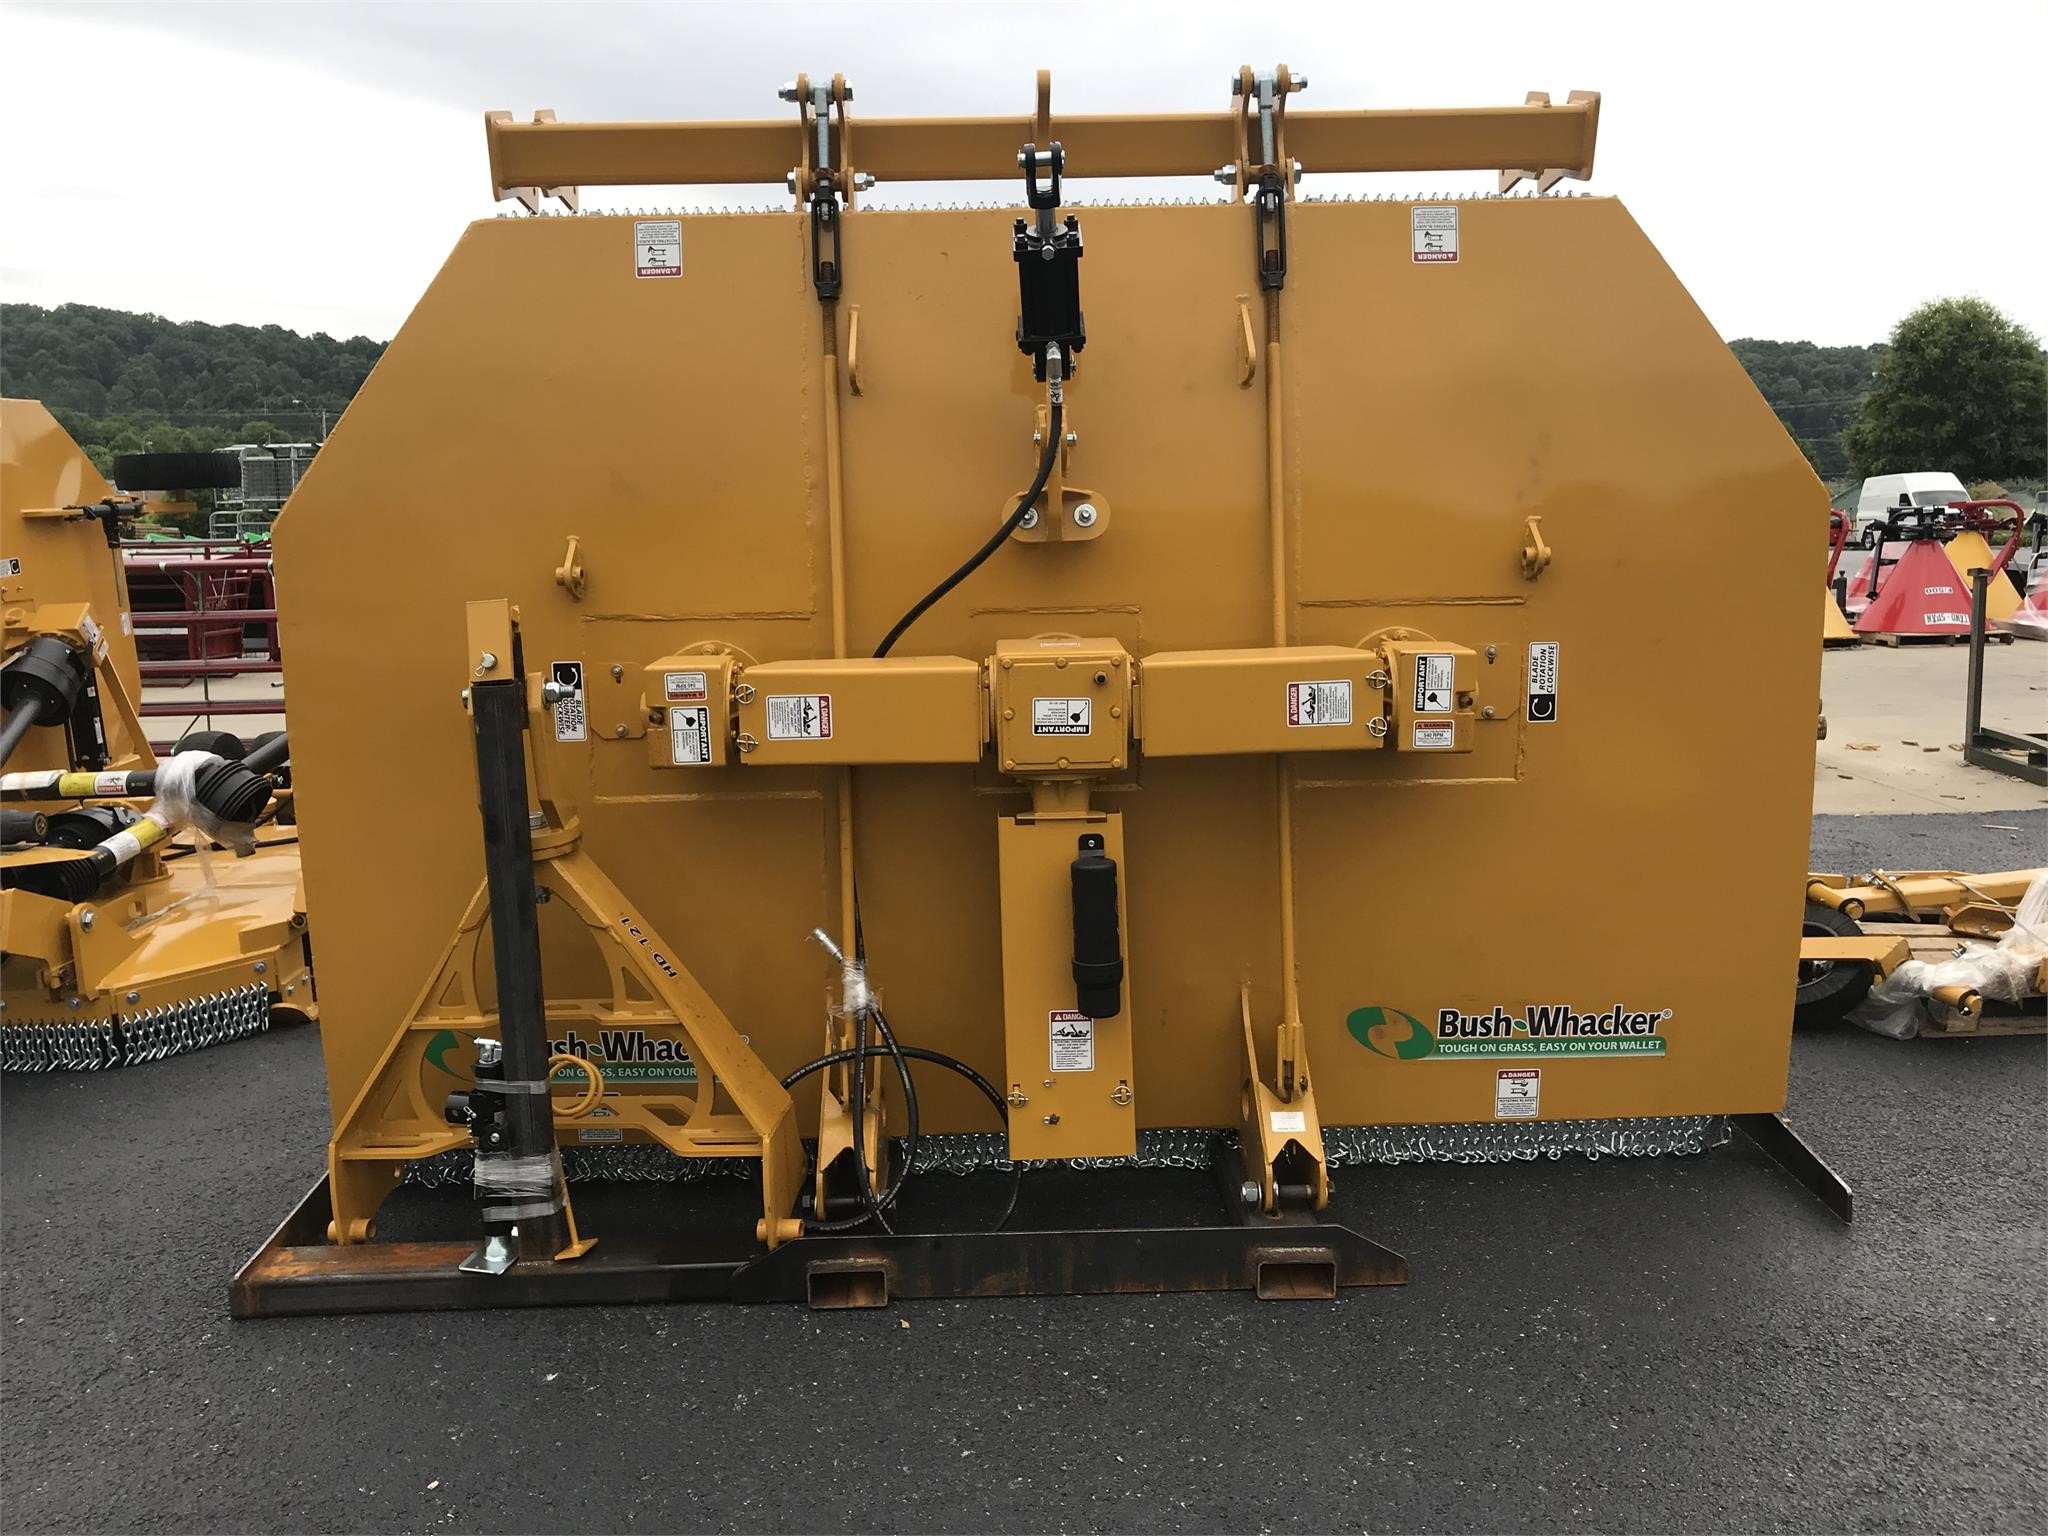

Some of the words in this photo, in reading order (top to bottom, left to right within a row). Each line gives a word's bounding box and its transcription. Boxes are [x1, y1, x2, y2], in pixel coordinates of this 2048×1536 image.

[1417, 659, 1426, 708] IMPORTANT
[1546, 645, 1555, 693] CLOCKWISE
[563, 699, 571, 732] OUNTER-
[569, 699, 577, 732] OTATION
[1290, 687, 1298, 713] DANGER
[557, 702, 565, 736] OCKWISE
[699, 711, 708, 759] IMPORTANT
[821, 708, 829, 734] DANGER
[620, 916, 679, 979] HD-121
[1439, 1043, 1477, 1053] TOUGH
[1480, 1043, 1496, 1052] ON
[1498, 1042, 1537, 1053] GRASS,
[1540, 1042, 1567, 1051] EASY
[1569, 1042, 1588, 1051] ON
[1588, 1041, 1618, 1050] YOUR
[1619, 1040, 1661, 1050] WALLET
[557, 1068, 575, 1077] ON
[618, 1067, 645, 1077] EASY
[647, 1067, 665, 1077] ON
[666, 1067, 697, 1077] YOUR
